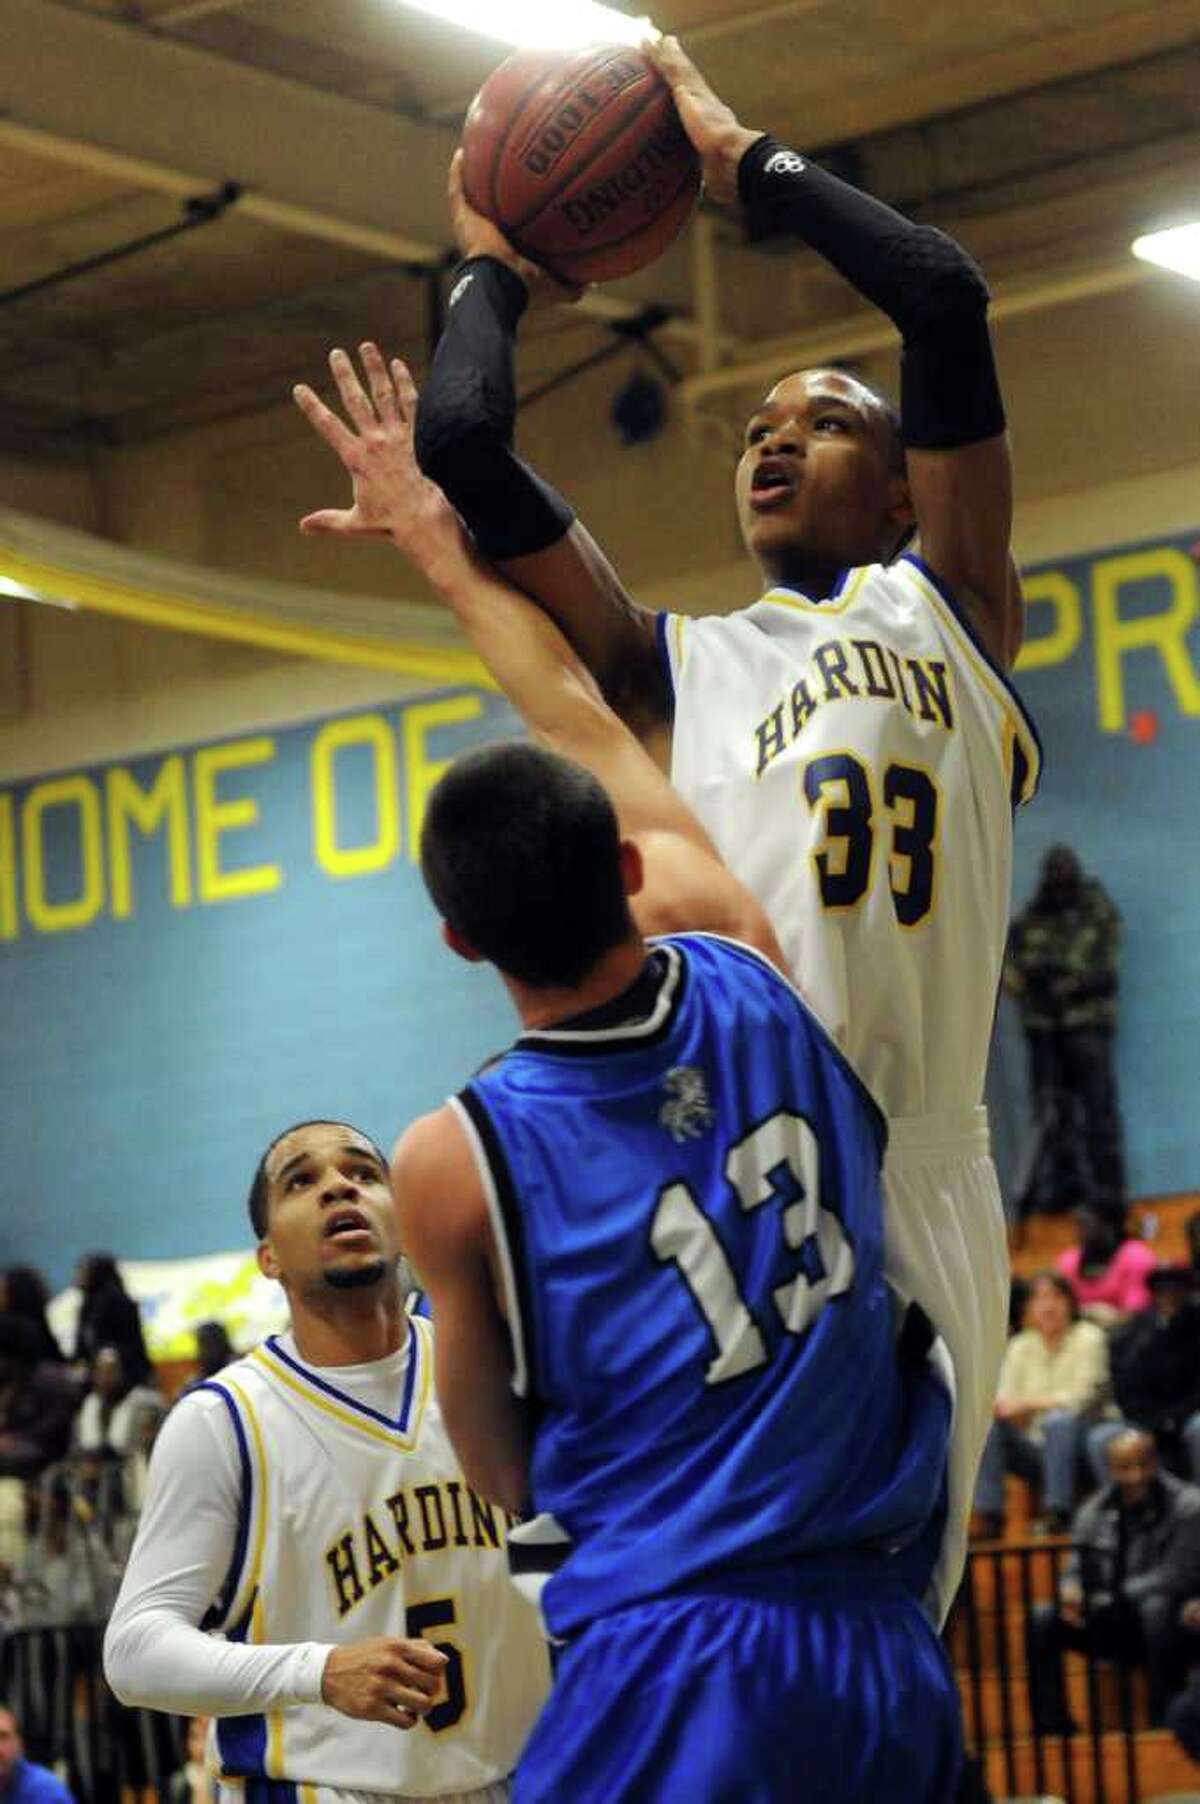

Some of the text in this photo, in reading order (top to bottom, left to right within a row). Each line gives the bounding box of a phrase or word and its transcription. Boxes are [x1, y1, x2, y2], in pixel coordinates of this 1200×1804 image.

[0, 736, 281, 940] OME
[311, 694, 482, 878] OF
[802, 751, 940, 928] 33
[650, 1111, 853, 1386] 13
[326, 1481, 520, 1616] HARDIN
[404, 1597, 467, 1733] 5
